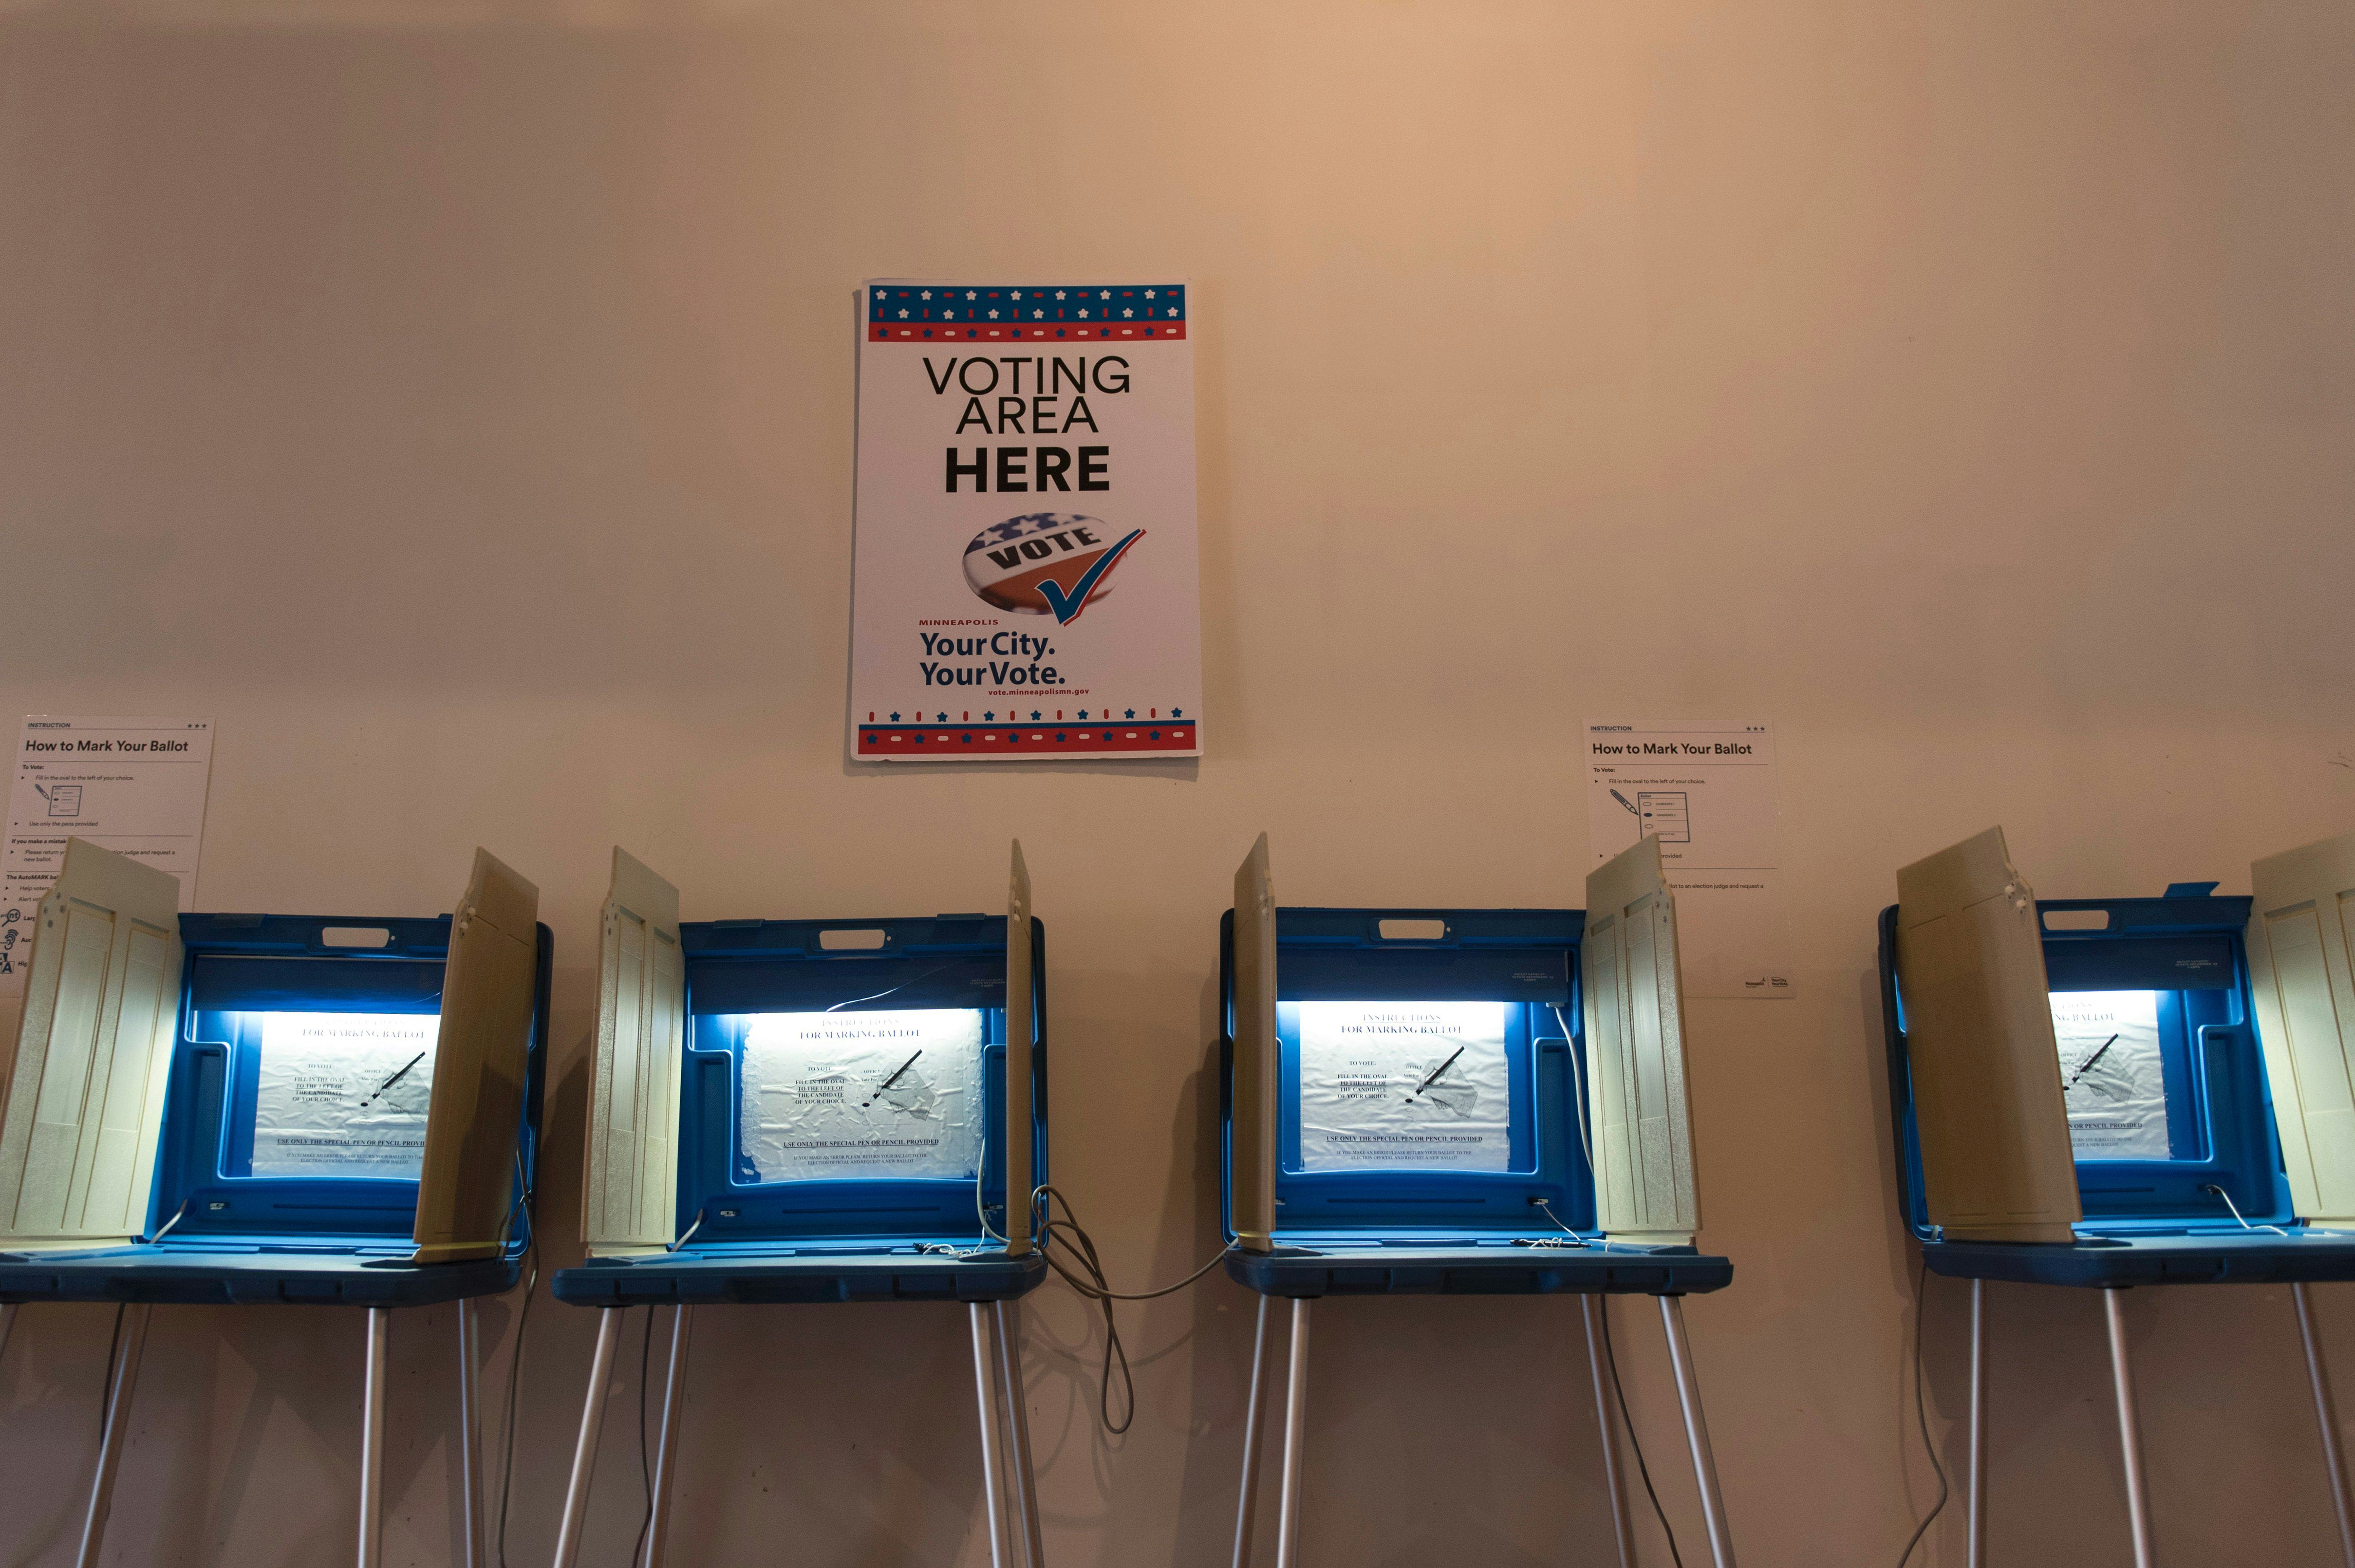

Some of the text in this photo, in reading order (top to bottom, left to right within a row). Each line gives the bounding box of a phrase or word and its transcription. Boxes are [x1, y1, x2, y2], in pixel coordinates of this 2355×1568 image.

[923, 356, 1130, 395] VOTING
[955, 396, 1099, 434] AREA
[946, 446, 1110, 493] HERE
[986, 527, 1102, 569] VOTE
[920, 631, 1055, 662] Your City.
[919, 661, 1065, 685] Your Vote.
[25, 740, 188, 751] How to Mark Your Ballot
[1592, 743, 1752, 754] How to Mark Your Ballot
